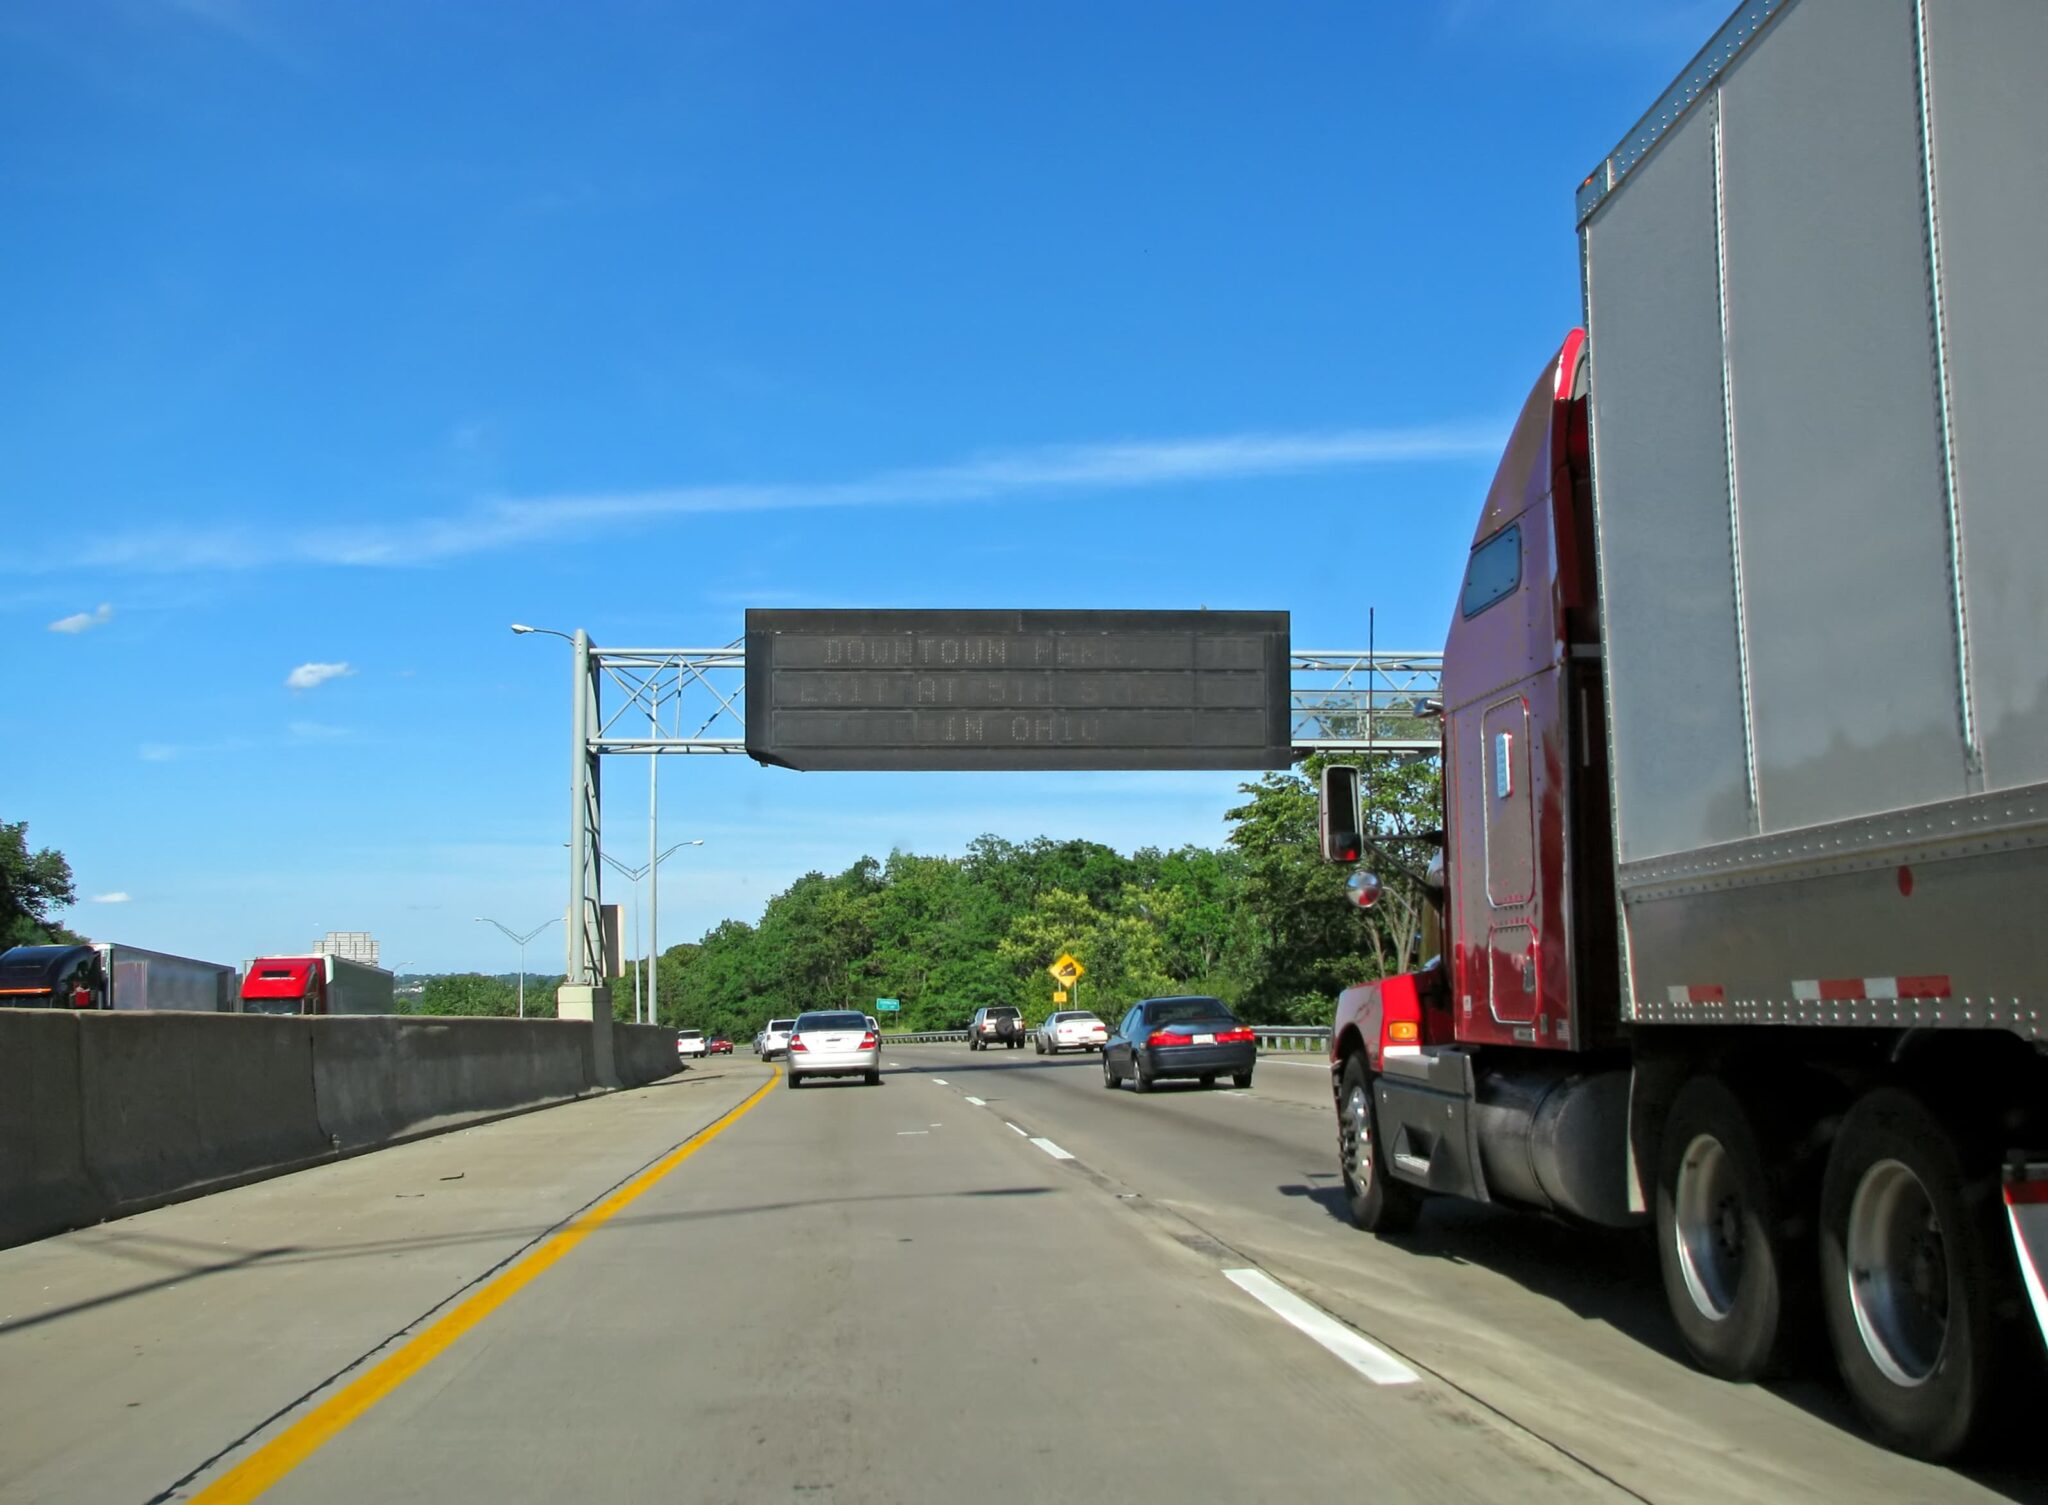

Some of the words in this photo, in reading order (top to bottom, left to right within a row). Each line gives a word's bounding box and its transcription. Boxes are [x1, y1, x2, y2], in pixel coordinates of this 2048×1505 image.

[824, 639, 1008, 664] DOWNTOWN
[916, 678, 959, 703] AT
[945, 716, 983, 741] IN
